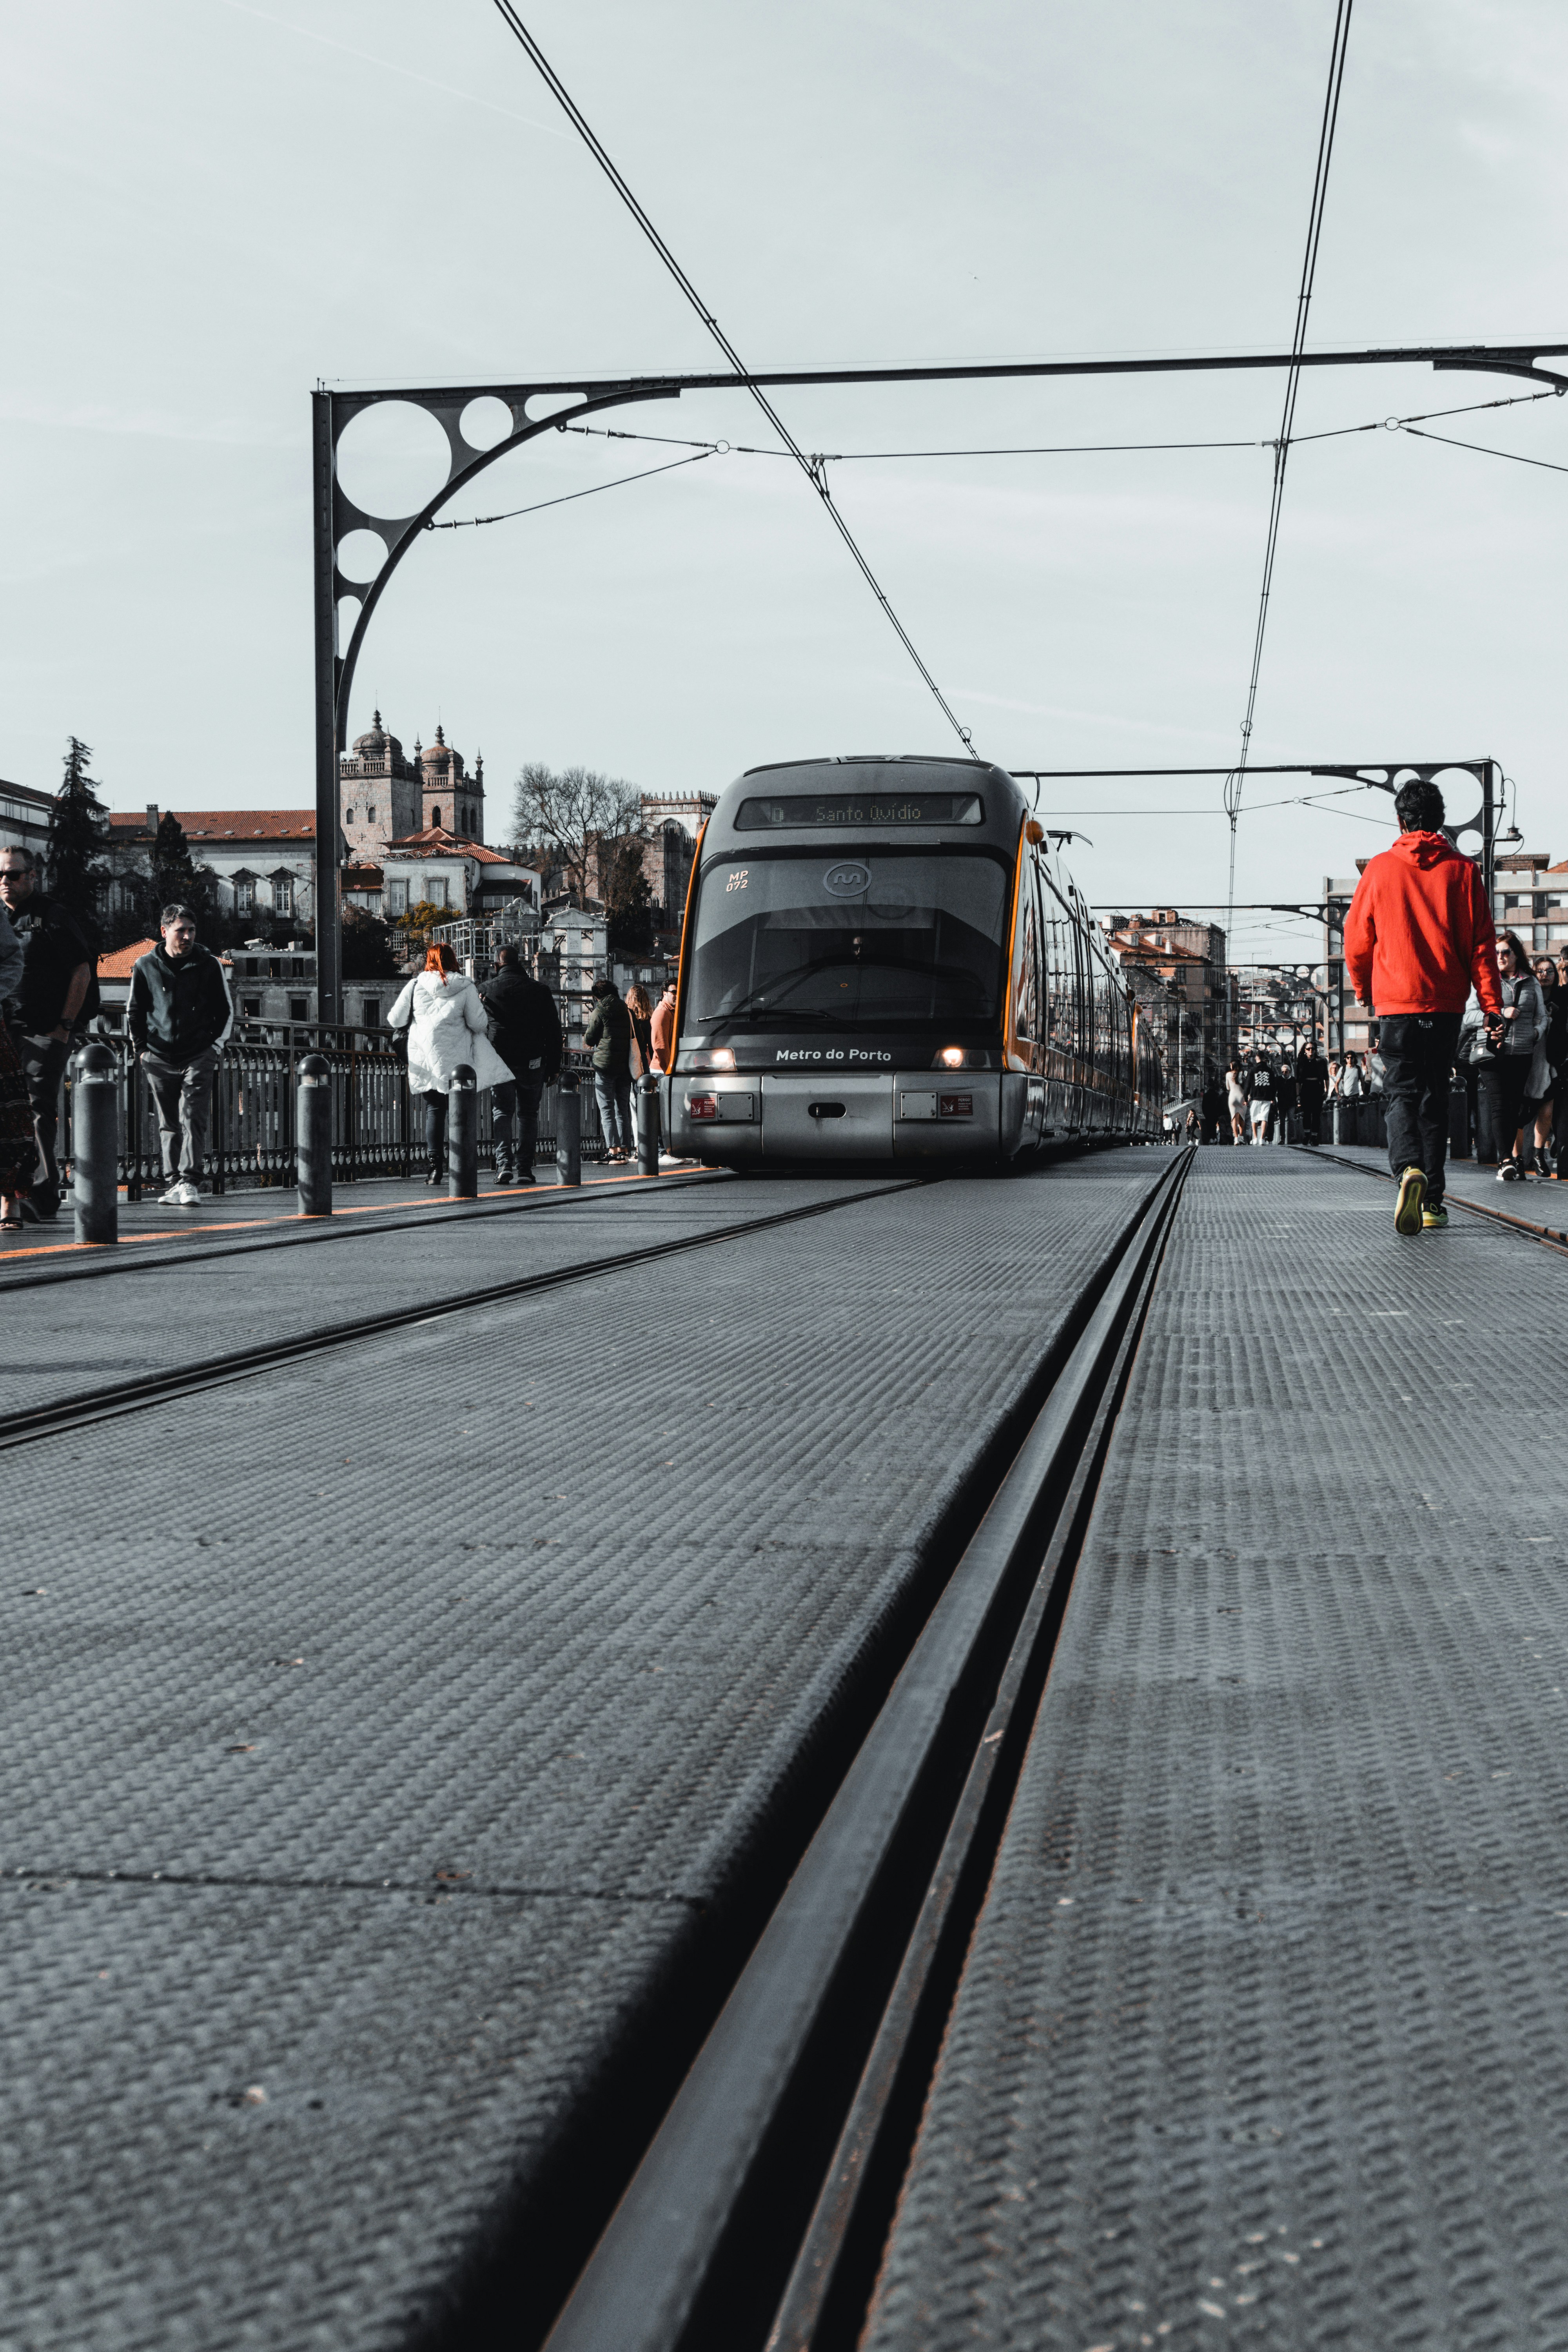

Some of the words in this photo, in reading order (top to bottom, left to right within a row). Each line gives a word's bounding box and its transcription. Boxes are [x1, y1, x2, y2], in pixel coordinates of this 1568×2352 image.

[817, 806, 863, 821] Santo
[730, 870, 748, 882] MP
[726, 879, 748, 892] 072
[776, 1050, 821, 1061] Metro
[826, 1049, 844, 1059] do
[849, 1049, 891, 1061] Porto
